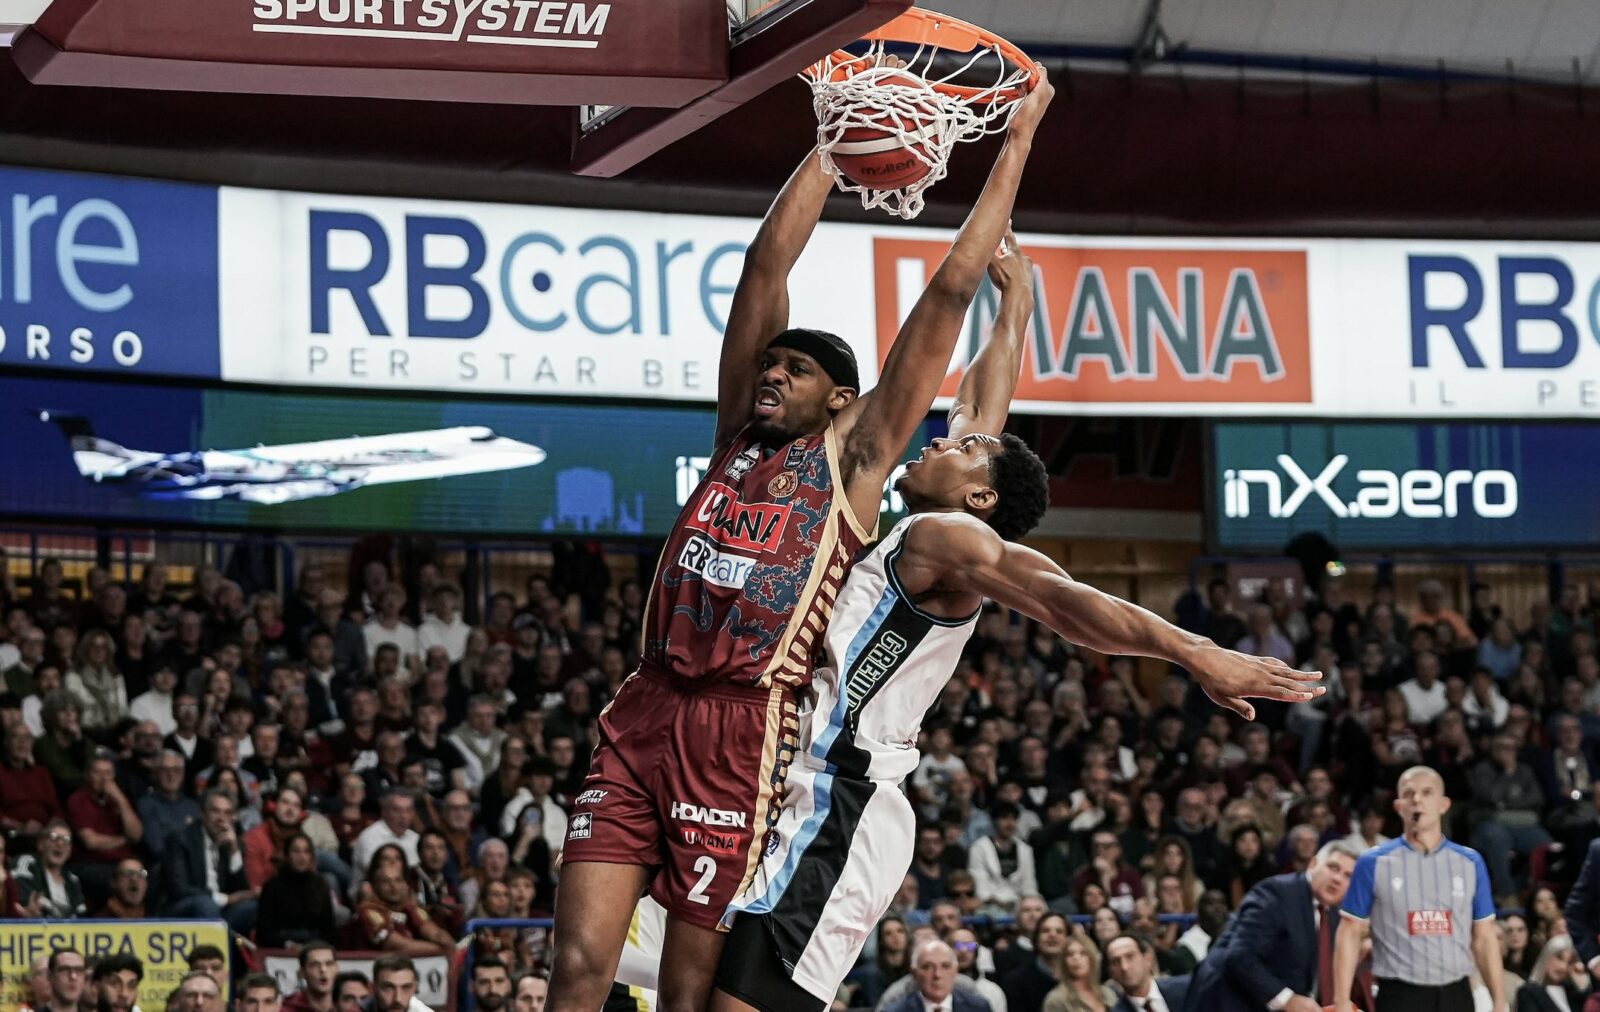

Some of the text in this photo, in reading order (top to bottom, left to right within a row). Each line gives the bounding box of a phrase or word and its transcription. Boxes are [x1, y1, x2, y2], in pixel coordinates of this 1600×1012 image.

[861, 159, 916, 176] molten
[309, 210, 748, 341] RBcare
[309, 346, 410, 377] PER
[458, 351, 597, 384] STAR
[1410, 379, 1455, 406] IL
[1224, 454, 1518, 518] inX.aero
[671, 801, 746, 828] HOWDEN
[687, 856, 717, 905] 2
